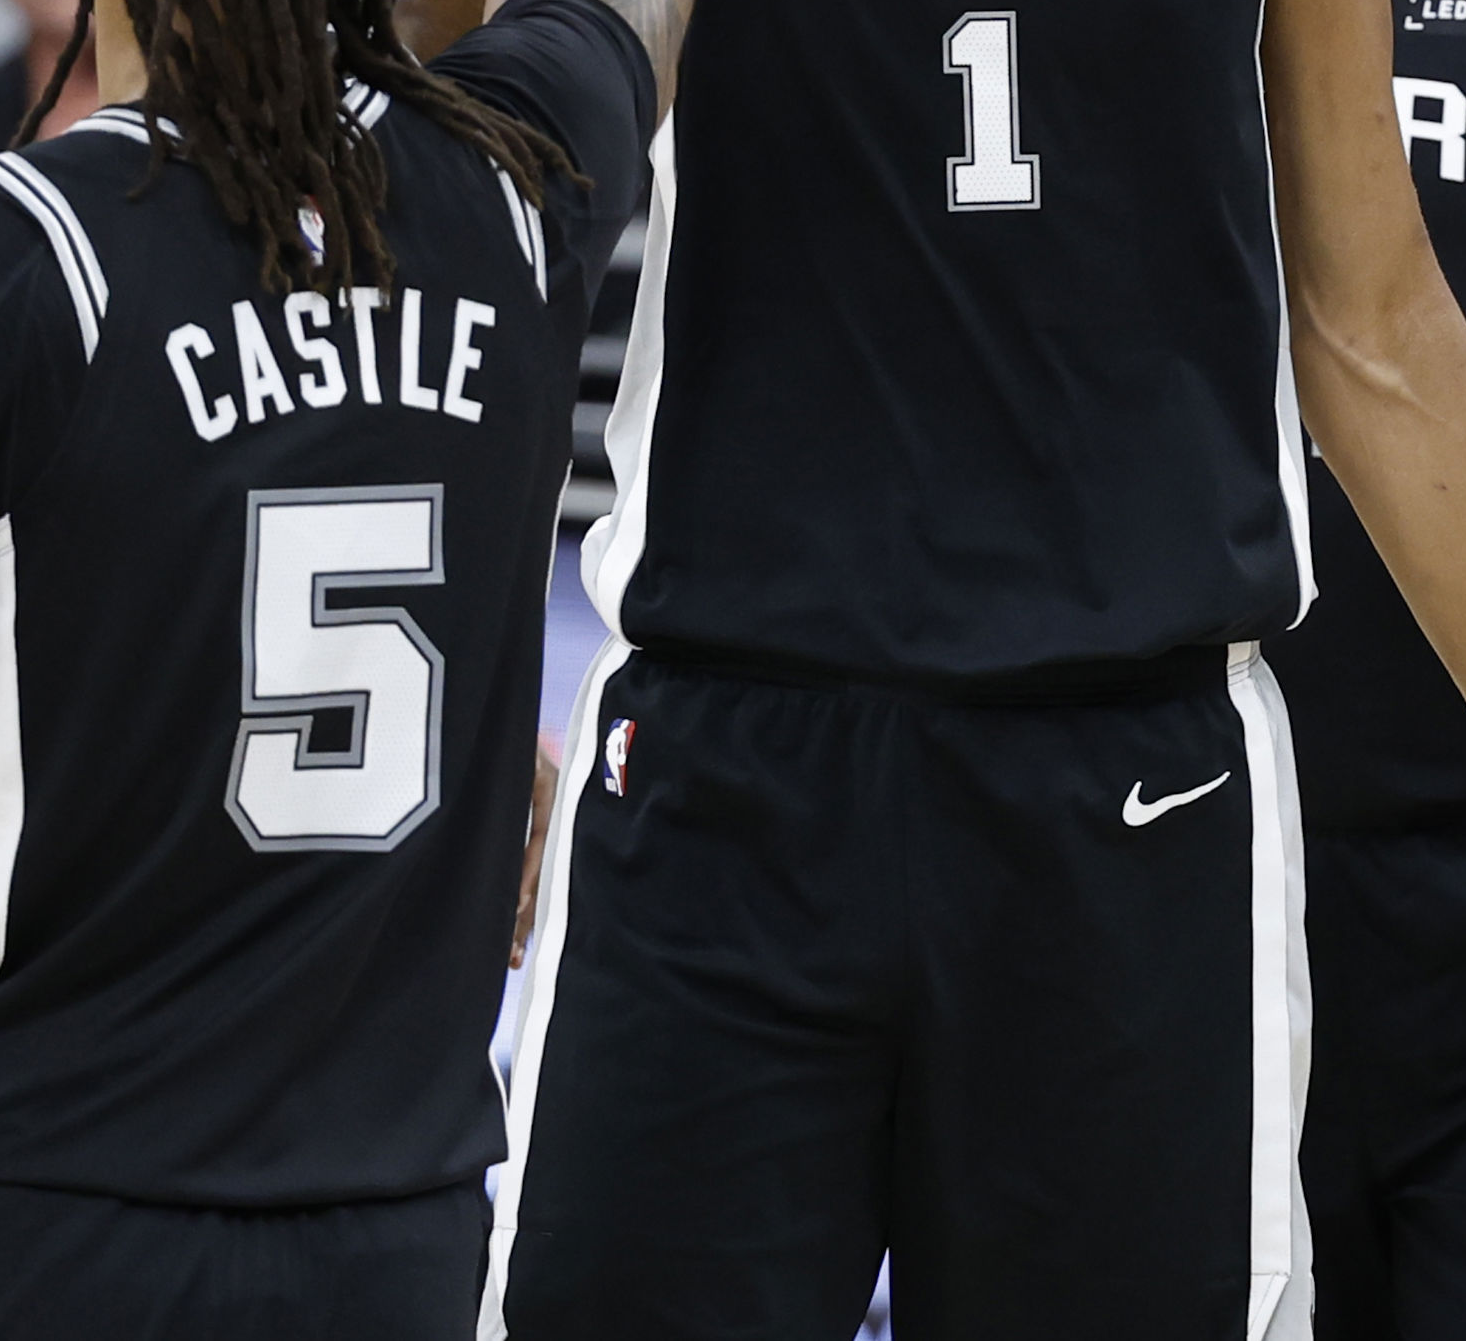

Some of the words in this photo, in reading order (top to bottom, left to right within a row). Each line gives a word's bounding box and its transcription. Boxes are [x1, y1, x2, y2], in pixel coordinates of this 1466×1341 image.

[942, 11, 1042, 212] 1
[165, 286, 496, 442] CASTLE
[224, 483, 445, 853] 5
